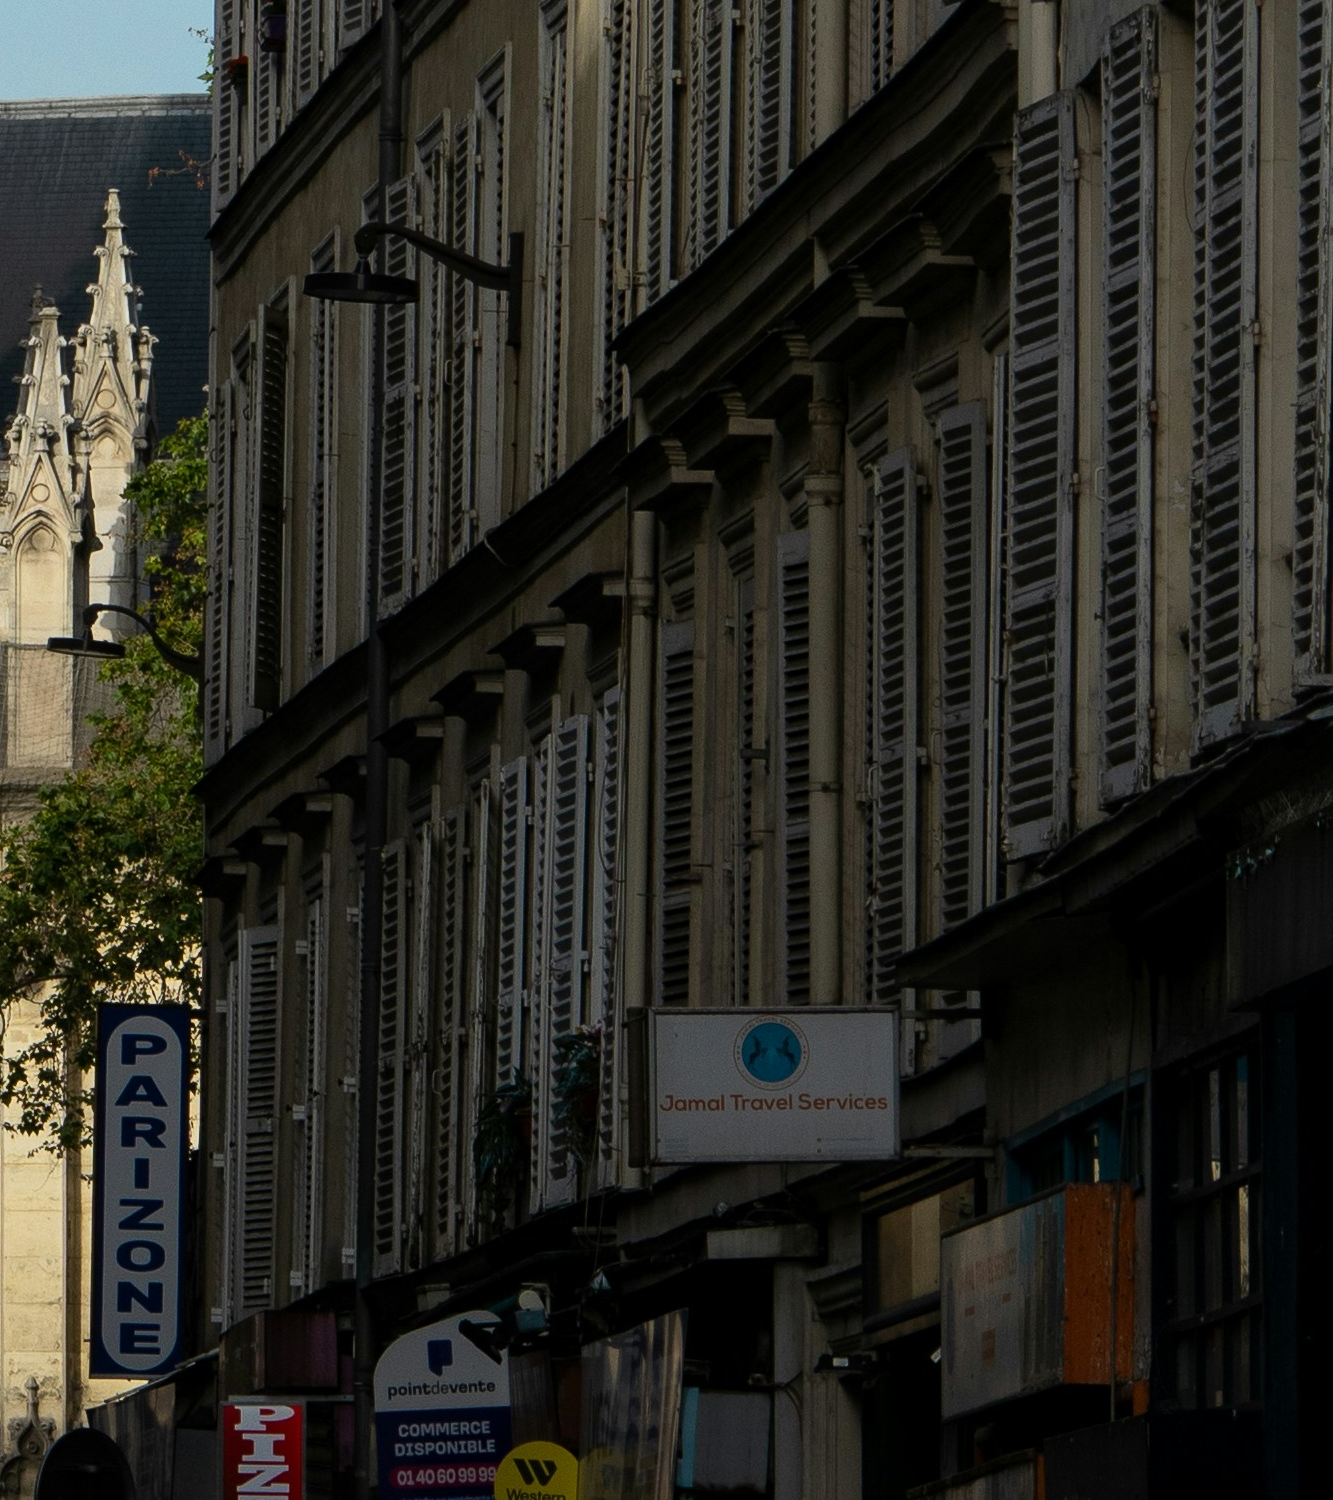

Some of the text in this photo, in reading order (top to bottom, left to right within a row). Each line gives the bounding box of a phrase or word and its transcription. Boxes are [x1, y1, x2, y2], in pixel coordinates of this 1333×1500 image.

[659, 1093, 889, 1112] Jamal Travel Services
[114, 1033, 169, 1355] PARIZONE
[387, 1379, 496, 1400] pointdevente
[398, 1420, 492, 1438] COMMERCE
[394, 1439, 496, 1458] DISPONIBLE
[396, 1467, 497, 1486] 01 40 60 99 99
